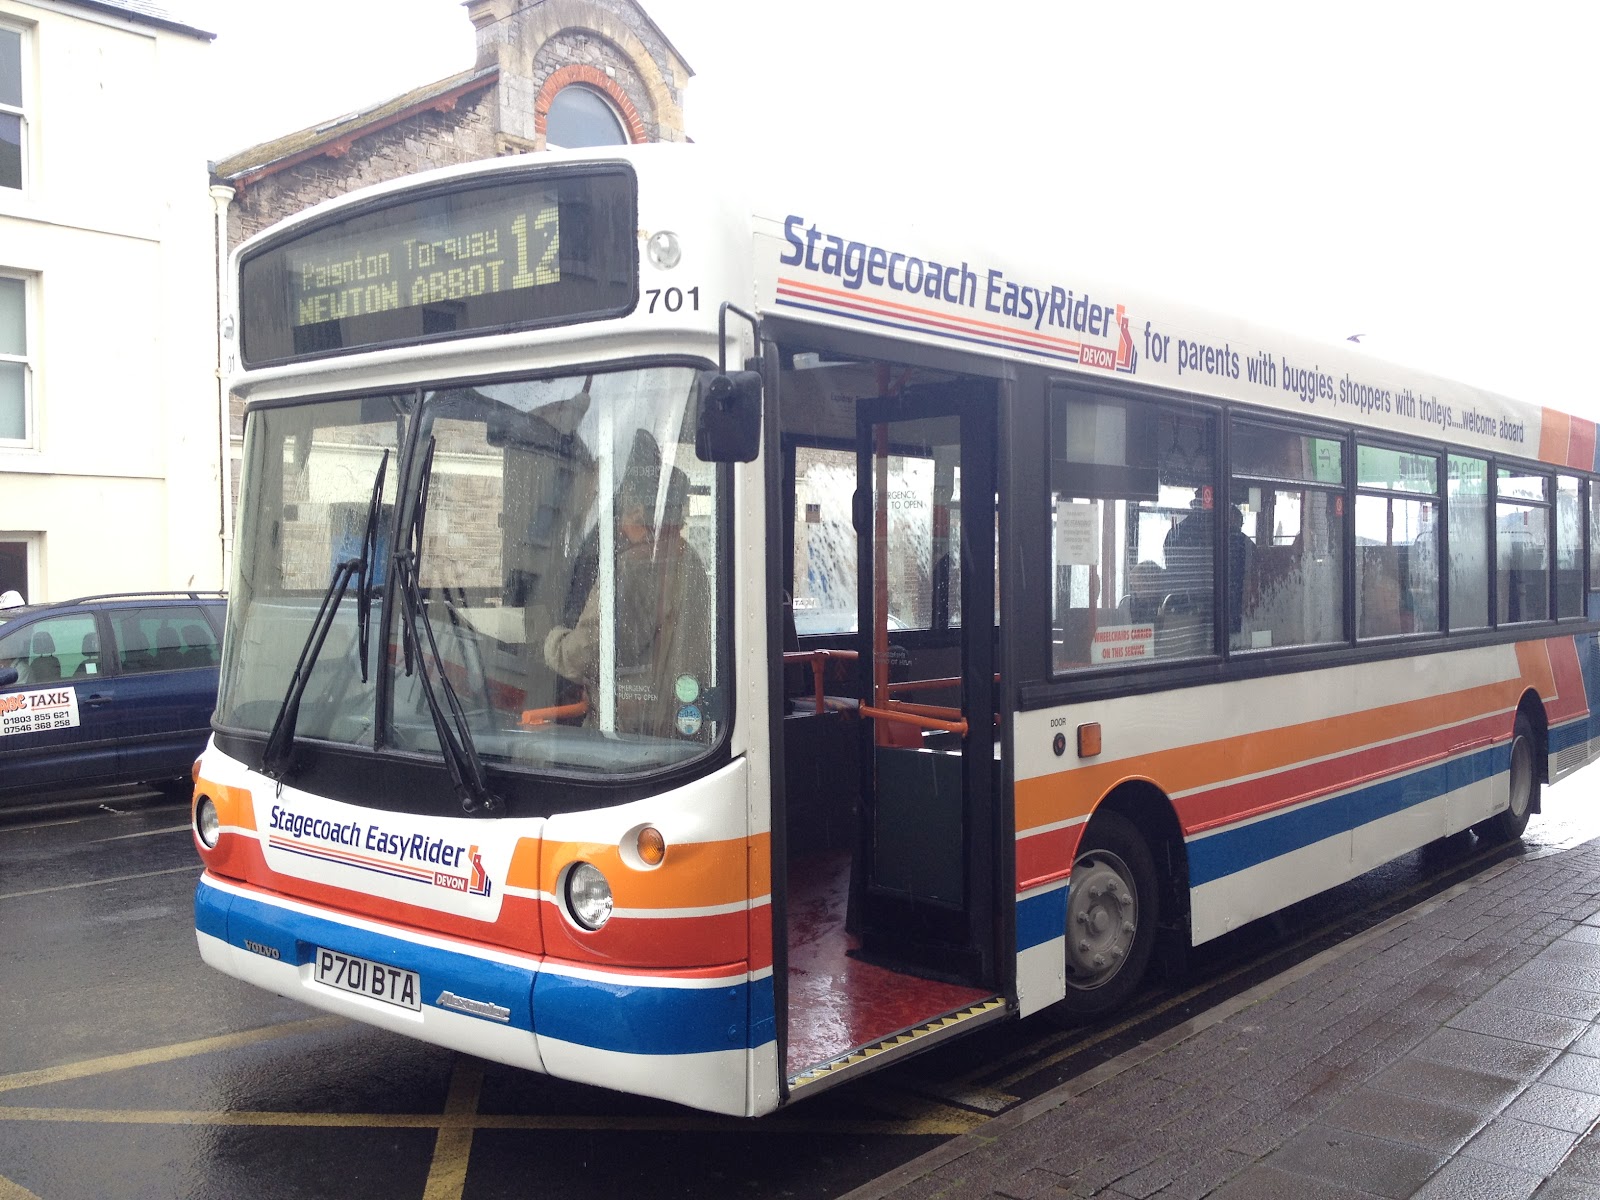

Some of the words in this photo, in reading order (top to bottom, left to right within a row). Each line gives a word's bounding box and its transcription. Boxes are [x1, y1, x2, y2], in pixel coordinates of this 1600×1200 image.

[402, 229, 499, 269] Torquay
[511, 206, 561, 289] 12
[780, 214, 977, 308] Stagecoach
[985, 268, 1115, 337] EasyRider
[299, 280, 398, 326] NEWTON
[412, 259, 505, 306] ABBOT
[646, 286, 699, 313] 701
[1082, 345, 1114, 368] DEVON
[1144, 321, 1170, 363] for
[1178, 339, 1240, 379] parents
[1246, 351, 1277, 388] with
[1282, 357, 1337, 408] buggies,
[1339, 373, 1391, 415] shoppers
[1395, 388, 1416, 418] with
[1500, 416, 1524, 443] aboard
[891, 501, 901, 509] TO
[904, 500, 923, 509] OPEN
[1094, 630, 1130, 643] WHEELCHAIRS
[1131, 628, 1152, 640] CARRIED
[1102, 648, 1111, 659] ON
[1112, 647, 1123, 658] THIS
[1125, 645, 1145, 657] SERVICE
[29, 692, 70, 707] TAXIS
[3, 715, 31, 725] 01803
[34, 712, 51, 721] 855
[53, 711, 69, 719] 621
[4, 724, 32, 734] 07546
[35, 721, 51, 730] 368
[54, 719, 71, 728] 258
[1050, 718, 1067, 728] DOOR
[269, 805, 360, 848] Stagecoach
[366, 825, 465, 868] EasyRider
[436, 874, 465, 890] DEVON
[243, 938, 280, 960] VOLVO
